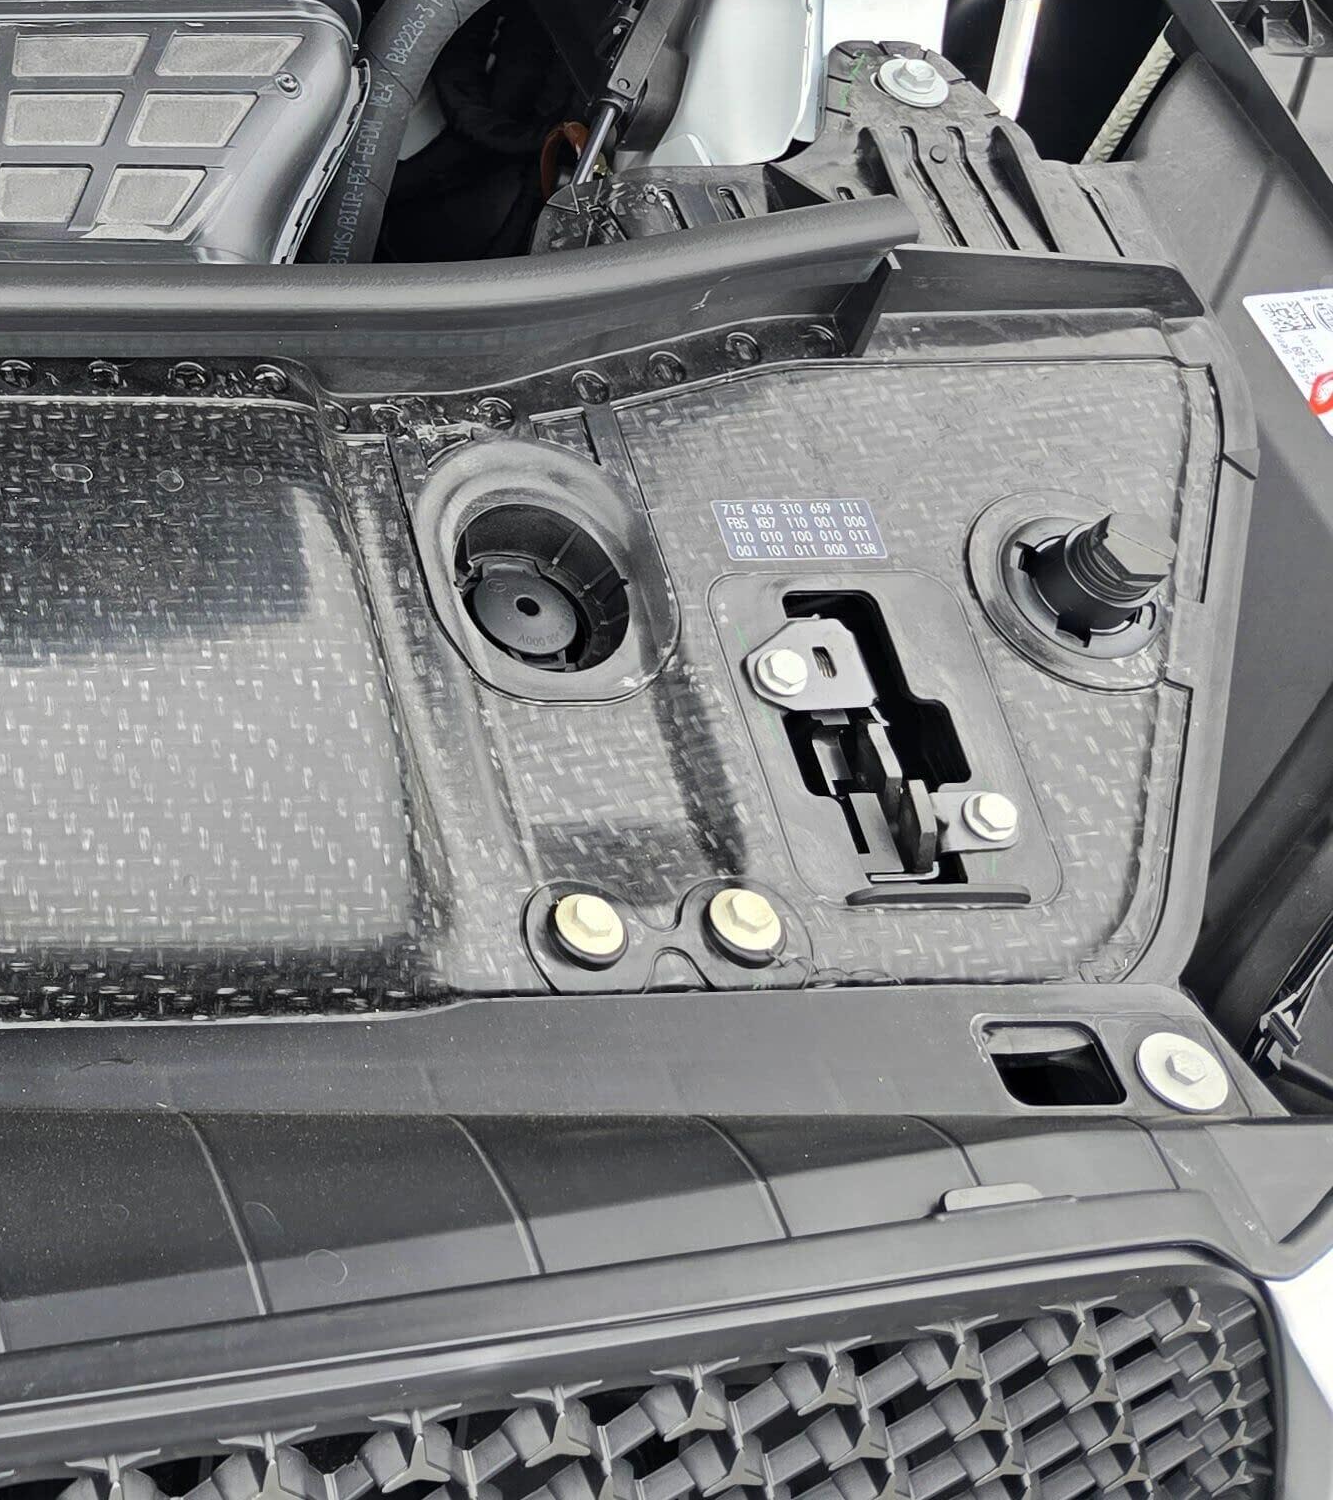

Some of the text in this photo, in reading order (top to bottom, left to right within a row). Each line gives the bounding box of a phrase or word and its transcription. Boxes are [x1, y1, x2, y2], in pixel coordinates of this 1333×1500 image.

[721, 504, 744, 515] 715
[781, 503, 802, 514] 310
[810, 503, 831, 514] 659
[839, 502, 860, 513] 111
[787, 517, 808, 528] 110
[814, 517, 835, 528] 001
[844, 516, 866, 527] 000
[733, 530, 871, 543] 110 010 100 010 011
[736, 543, 877, 557] 001 101 011 000 138
